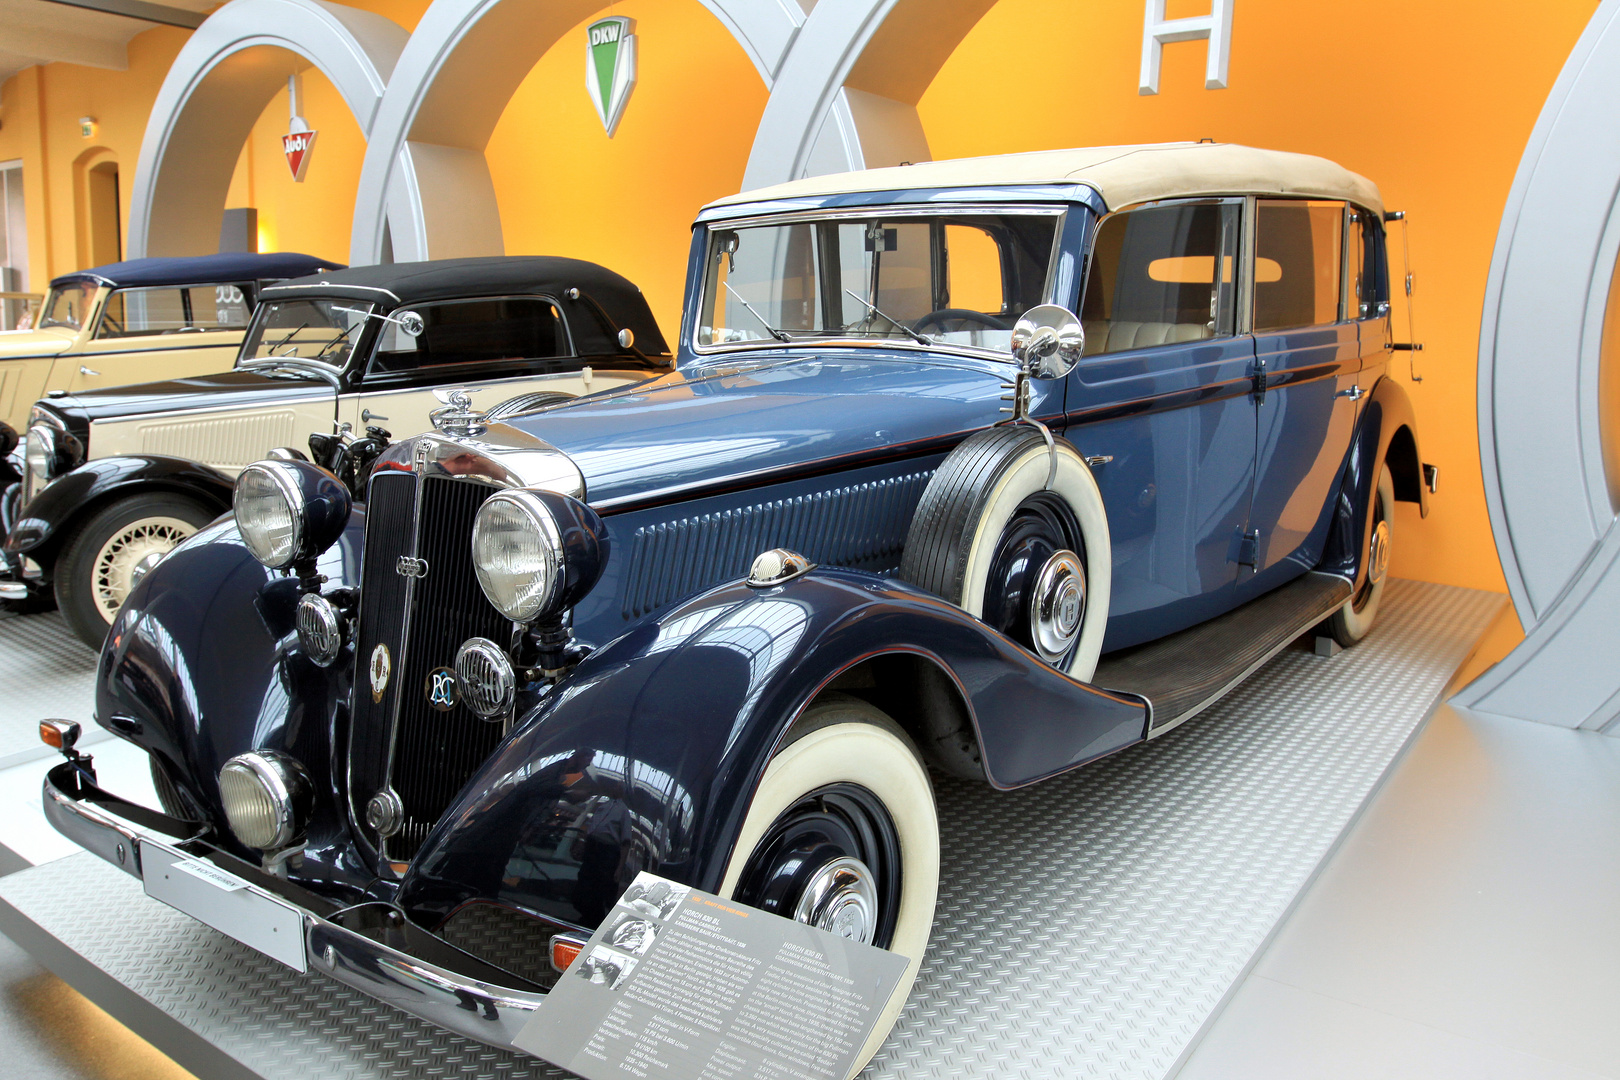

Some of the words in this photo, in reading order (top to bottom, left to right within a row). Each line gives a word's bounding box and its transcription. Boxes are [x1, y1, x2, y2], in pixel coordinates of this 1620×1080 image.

[591, 24, 620, 46] DKW
[285, 135, 306, 154] Audi
[682, 908, 703, 919] HORCH
[701, 915, 713, 923] 830
[782, 942, 805, 954] HORCH
[803, 949, 816, 957] 830
[814, 953, 825, 961] BL
